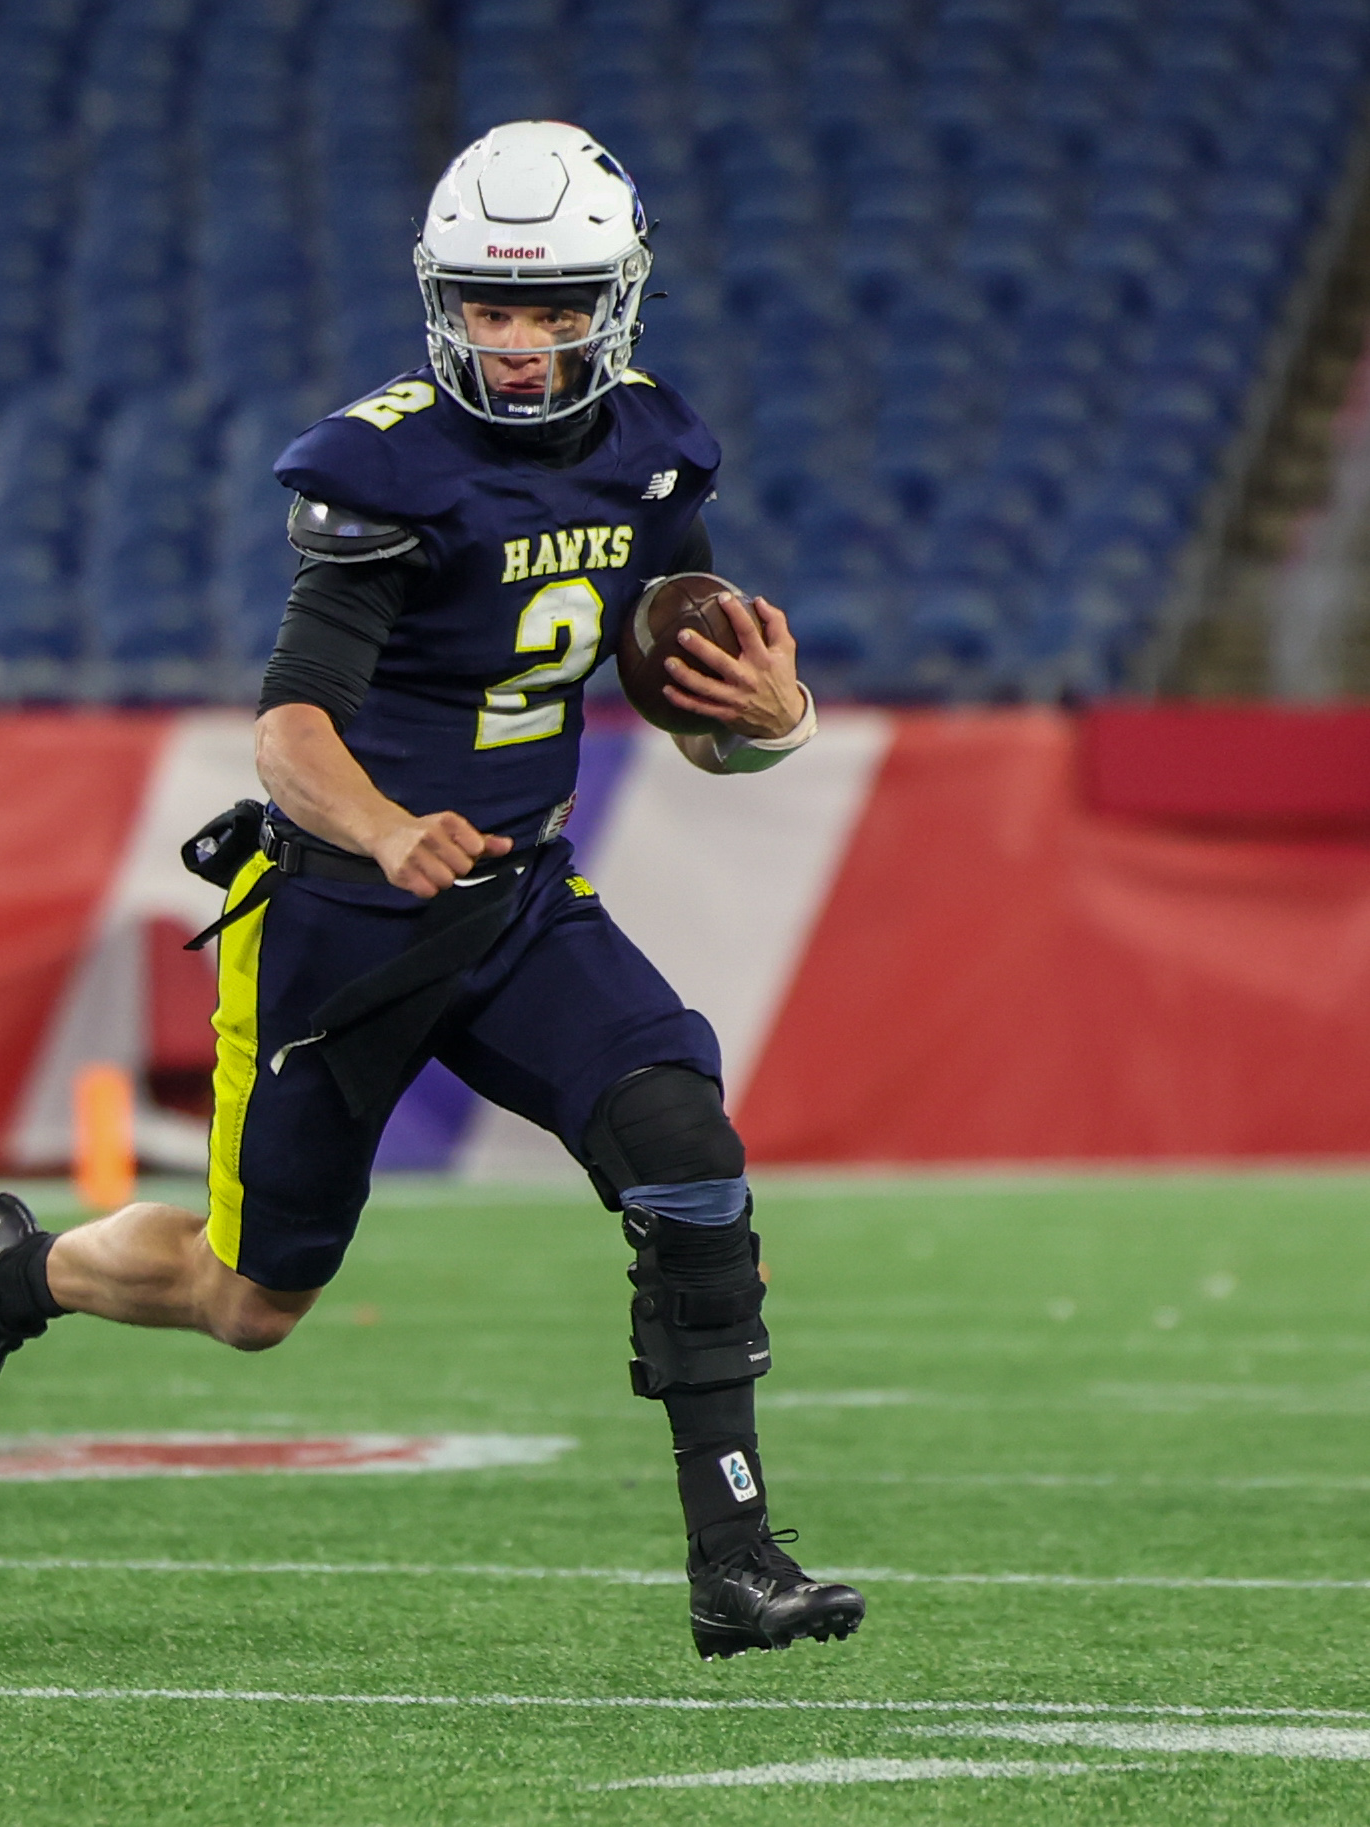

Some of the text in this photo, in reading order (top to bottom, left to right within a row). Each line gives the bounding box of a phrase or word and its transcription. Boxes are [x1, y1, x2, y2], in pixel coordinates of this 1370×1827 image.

[487, 245, 545, 259] Riddell
[344, 381, 435, 431] 2
[501, 525, 633, 584] HAWKS
[474, 576, 604, 750] 2
